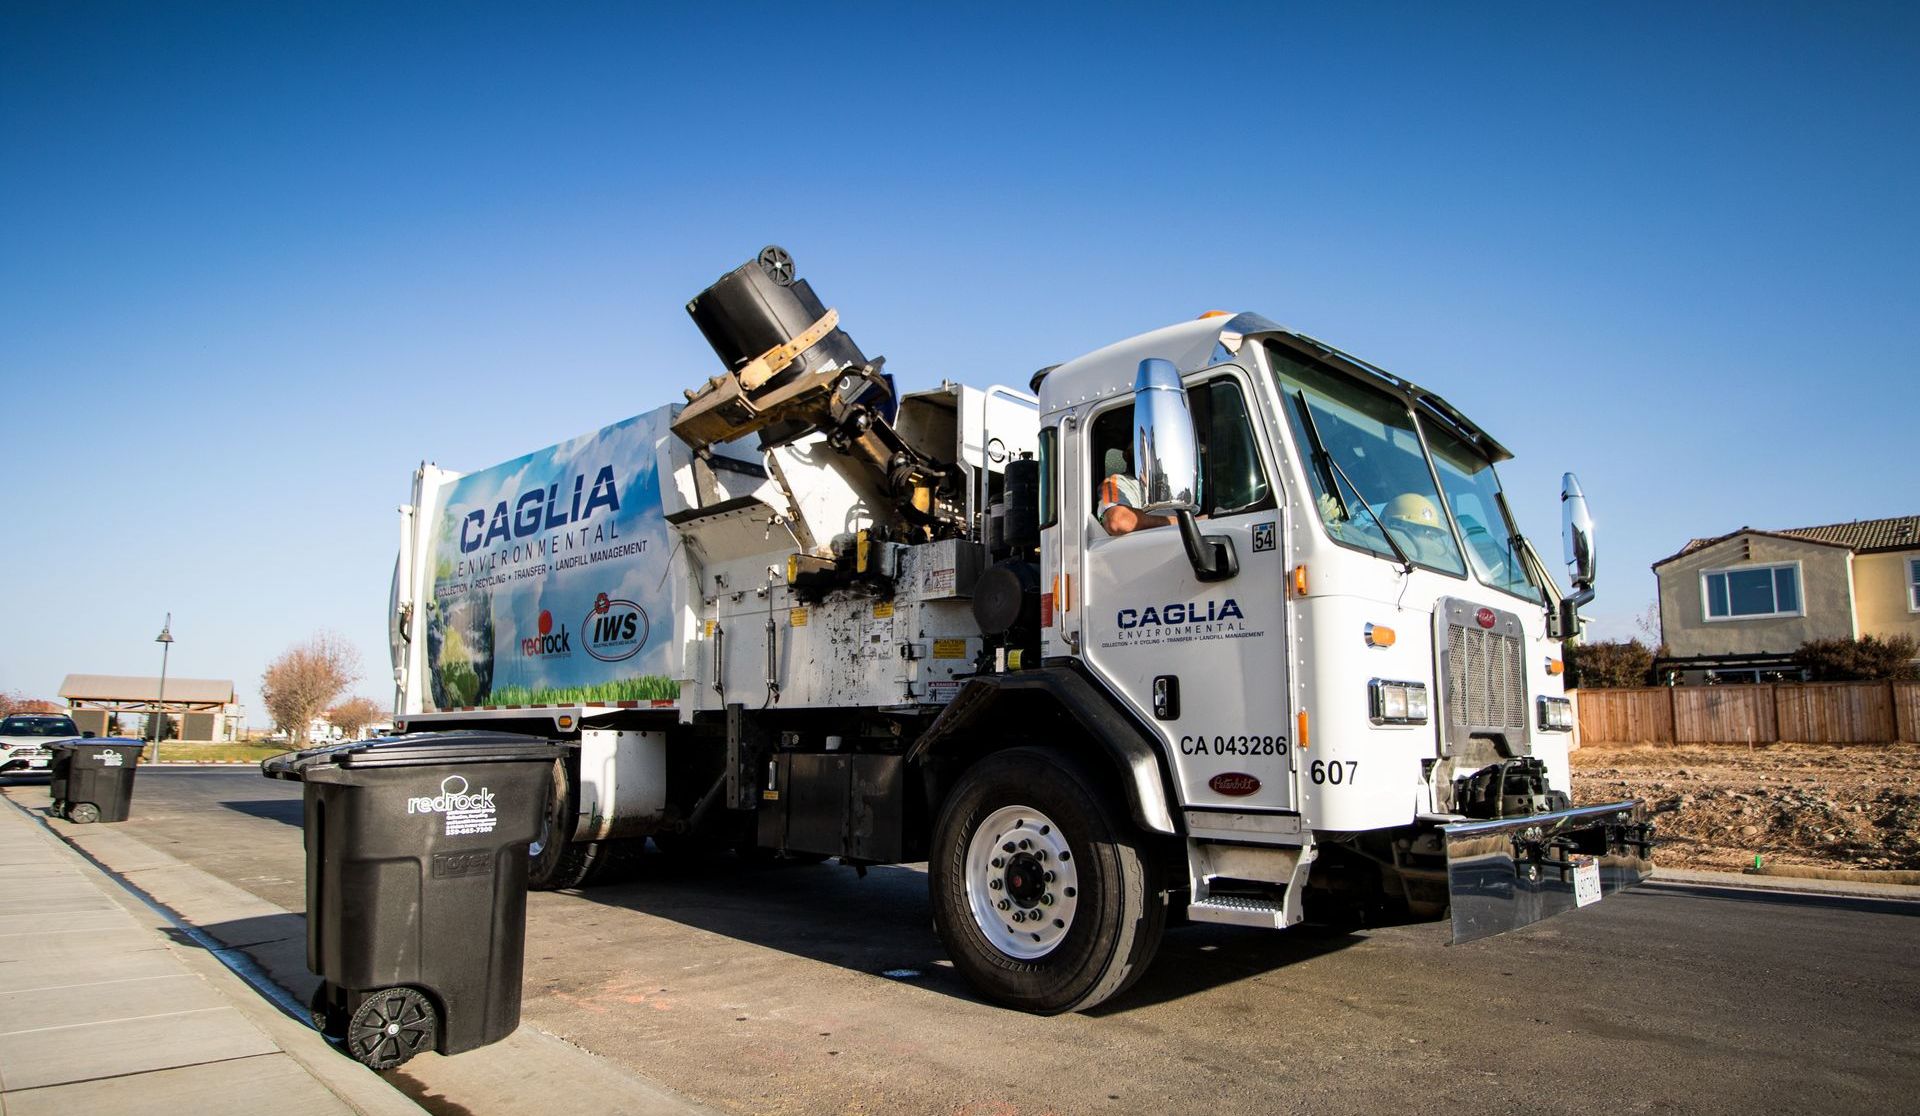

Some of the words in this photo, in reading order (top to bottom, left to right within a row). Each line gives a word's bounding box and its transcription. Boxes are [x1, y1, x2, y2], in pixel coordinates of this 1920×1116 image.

[460, 464, 620, 554] CAGLIA
[458, 520, 619, 577] ENVIRONMENTAL
[1255, 530, 1272, 549] 54
[438, 583, 468, 598] COLLECTION
[475, 572, 506, 589] RECYCLING
[514, 564, 546, 581] TRANSFER
[555, 553, 588, 571] LANDFILL
[590, 540, 648, 564] MANAGEMENT
[593, 612, 638, 643] IWS
[1117, 599, 1244, 629] CAGLIA
[521, 622, 570, 657] redrock
[1118, 622, 1246, 640] ENVIRONMENTAL
[1225, 631, 1264, 639] MANAGEMENT
[1180, 736, 1208, 756] CA
[1214, 736, 1288, 756] 043286
[1213, 776, 1257, 790] Peterbilt
[1310, 760, 1358, 786] 607
[407, 787, 496, 814] redrock
